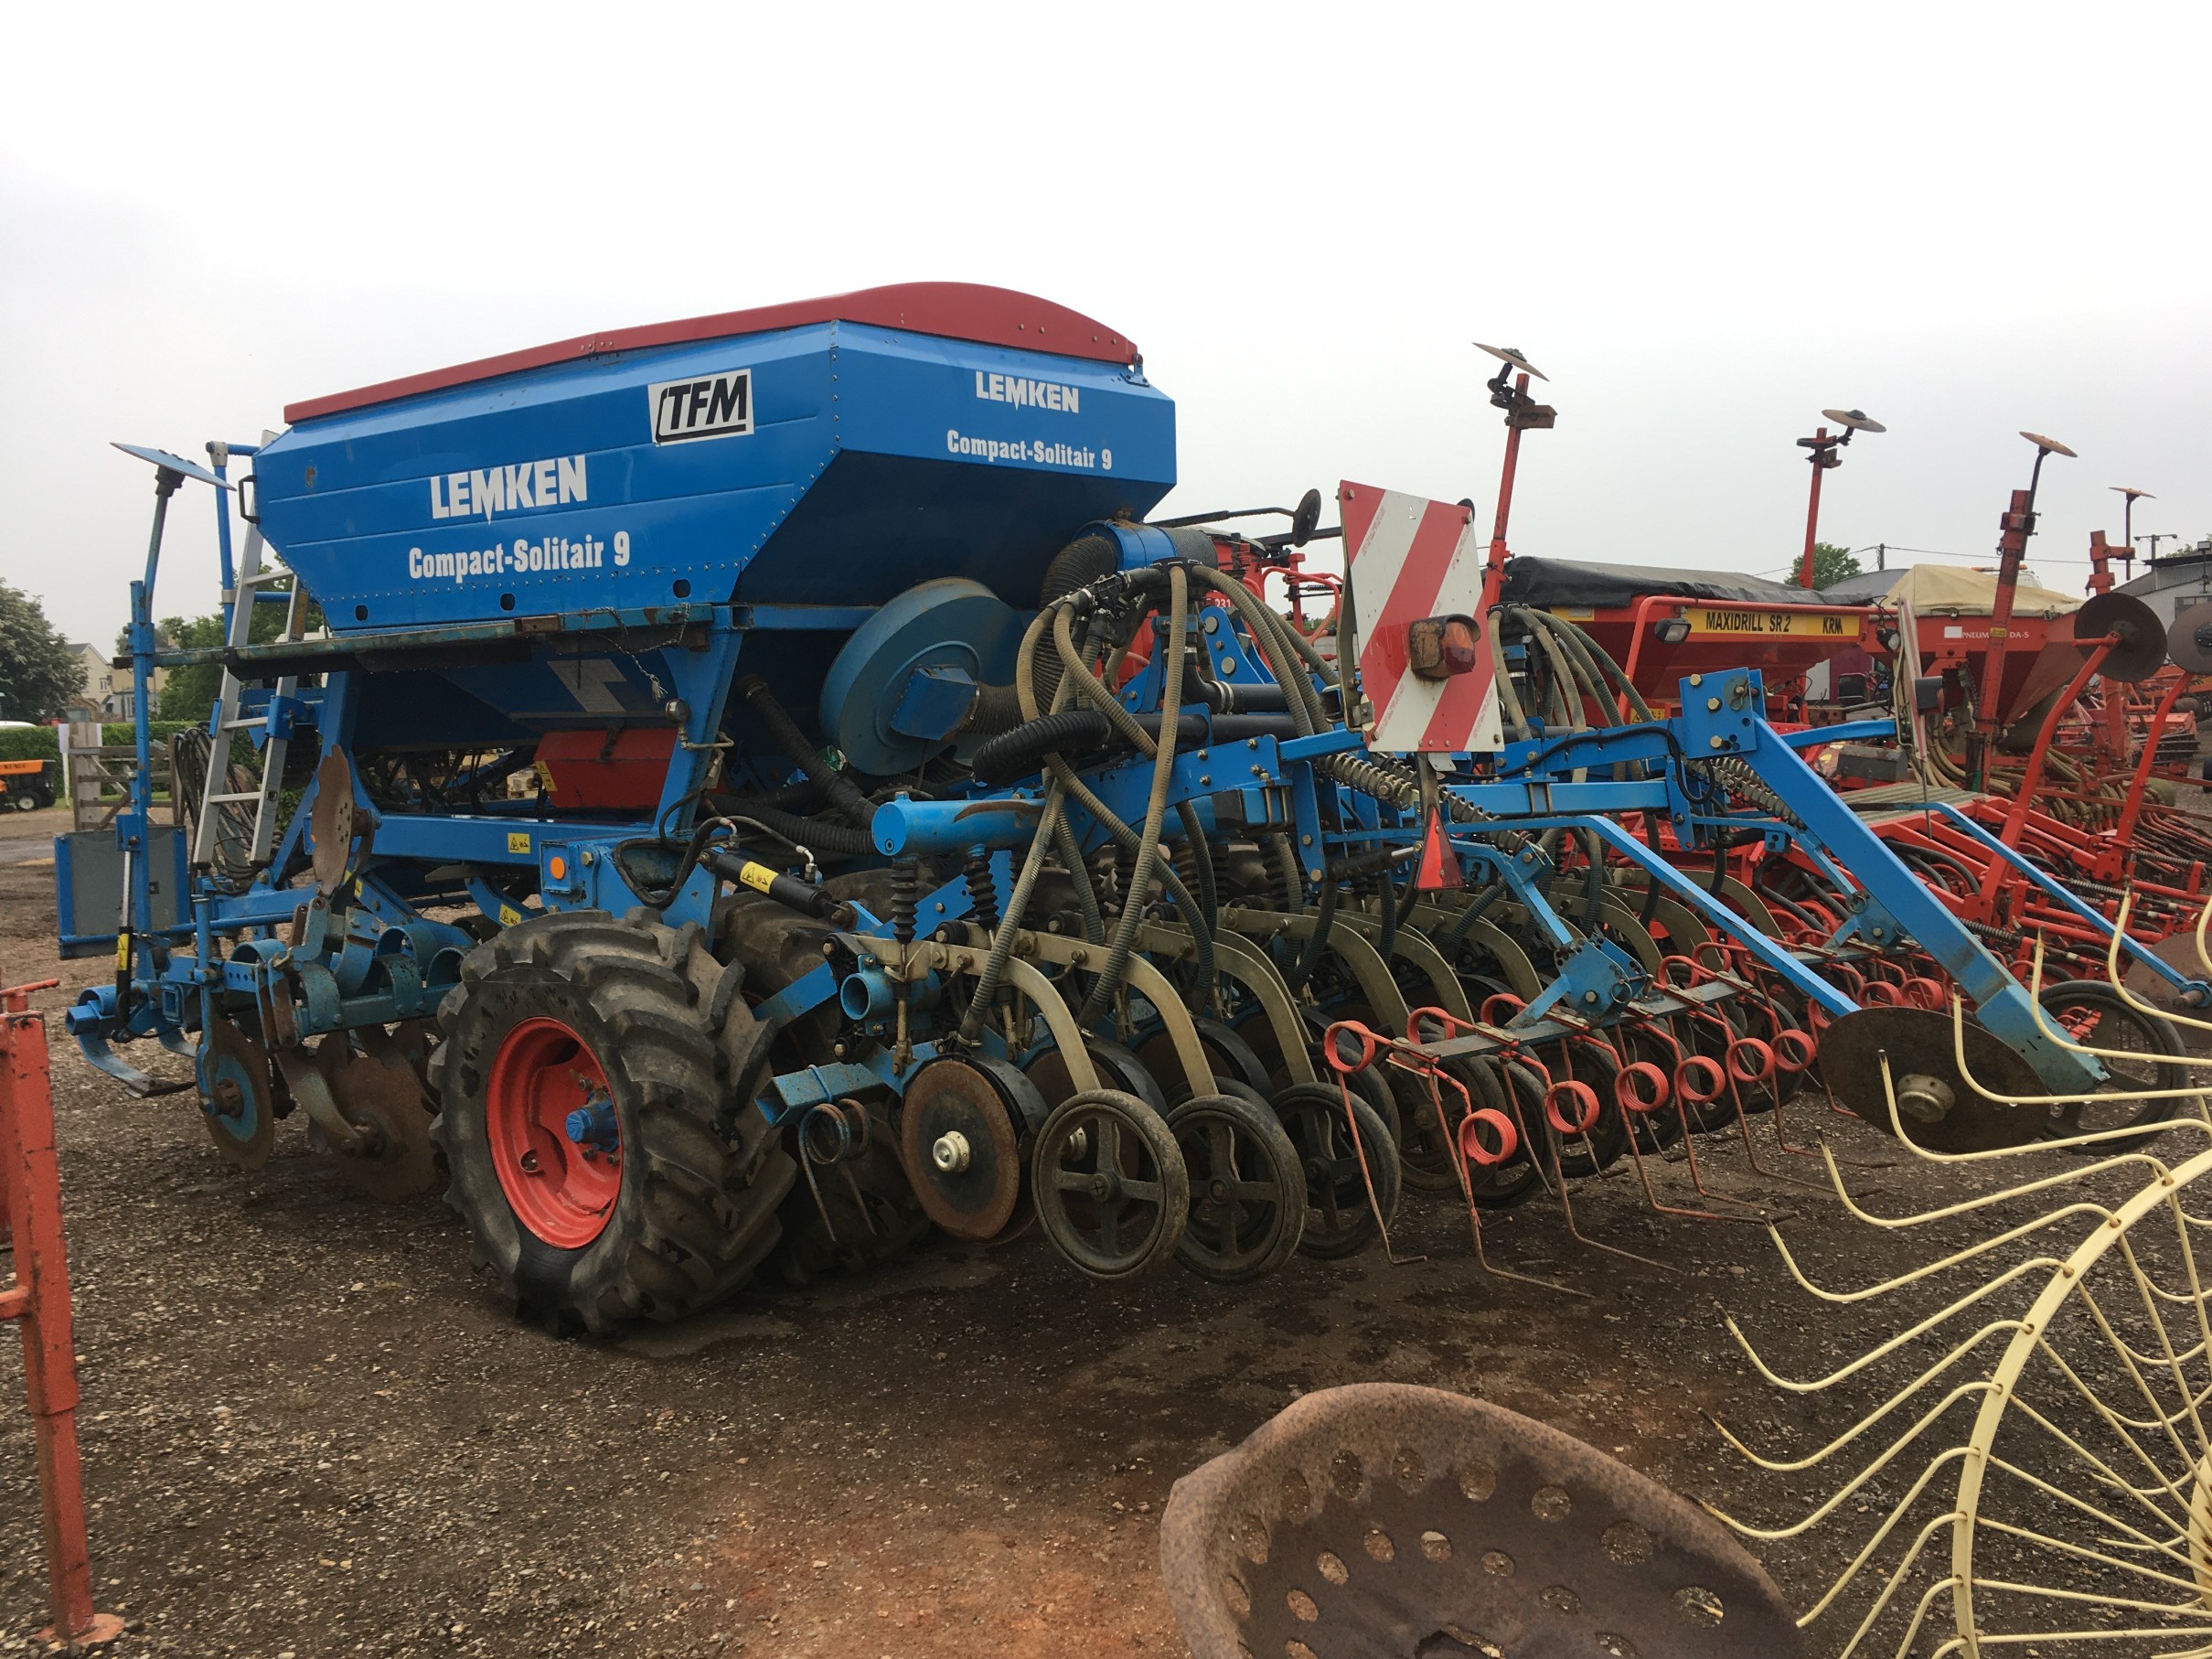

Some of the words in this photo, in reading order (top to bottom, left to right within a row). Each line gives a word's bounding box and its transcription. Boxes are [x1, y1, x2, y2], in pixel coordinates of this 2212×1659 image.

[668, 374, 748, 430] TFM
[976, 370, 1079, 413] LEMKEN
[946, 429, 1095, 468] Compact-Solitair
[1101, 448, 1112, 470] 9
[430, 455, 588, 525] LEMKEN
[409, 534, 604, 583] Compact-Solitair
[614, 530, 630, 566] 9
[1705, 611, 1763, 632] MAXIDRILL
[1822, 616, 1843, 635] KRM
